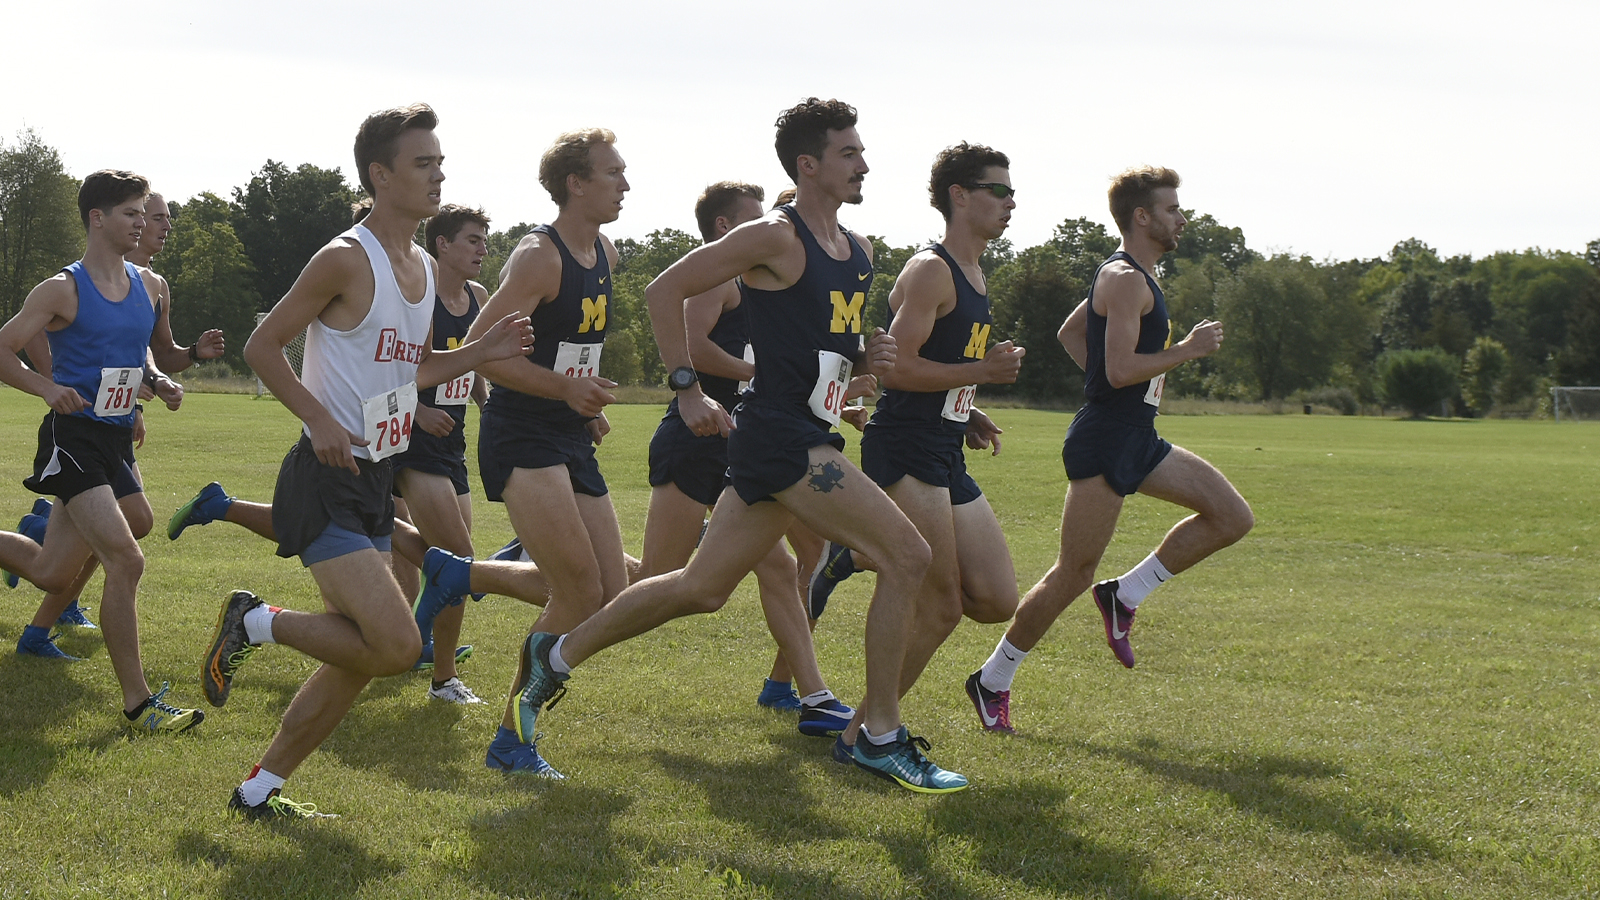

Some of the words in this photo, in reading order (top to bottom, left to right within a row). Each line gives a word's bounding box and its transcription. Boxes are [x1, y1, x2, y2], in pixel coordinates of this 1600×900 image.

[578, 294, 607, 333] M
[830, 291, 864, 333] M
[964, 322, 991, 359] M
[104, 387, 133, 410] 781
[376, 412, 411, 451] 784
